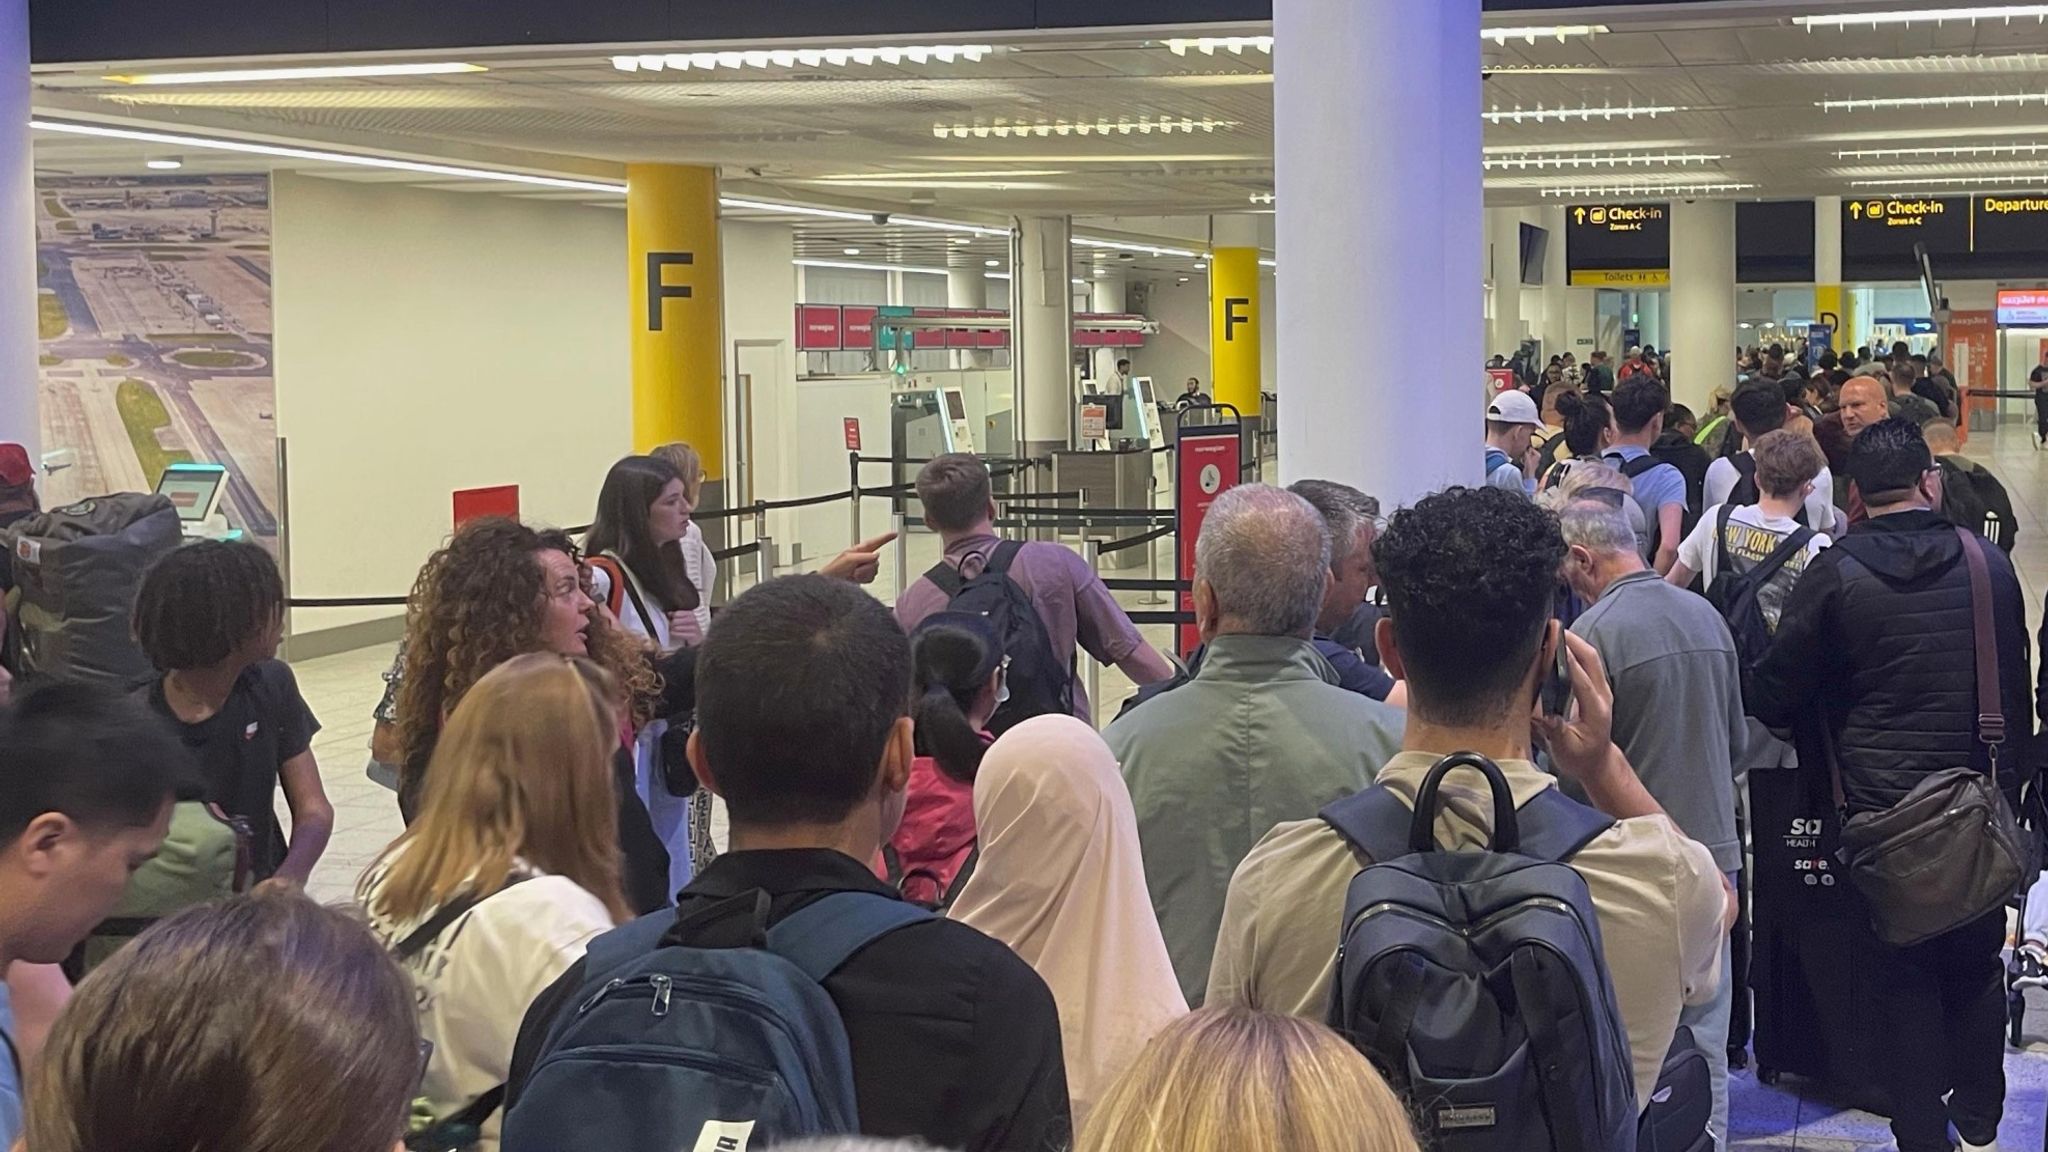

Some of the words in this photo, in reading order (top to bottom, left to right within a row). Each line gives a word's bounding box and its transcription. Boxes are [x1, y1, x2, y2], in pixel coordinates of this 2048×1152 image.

[1609, 207, 1662, 220] Check-in
[1887, 200, 1943, 215] Check-in
[1629, 223, 1642, 231] A-C
[1908, 217, 1922, 225] A-C
[1604, 272, 1634, 281] Toilets
[647, 252, 693, 331] F
[1225, 298, 1249, 341] F
[1744, 528, 1777, 554] YORK
[1786, 839, 1816, 848] HEALTH
